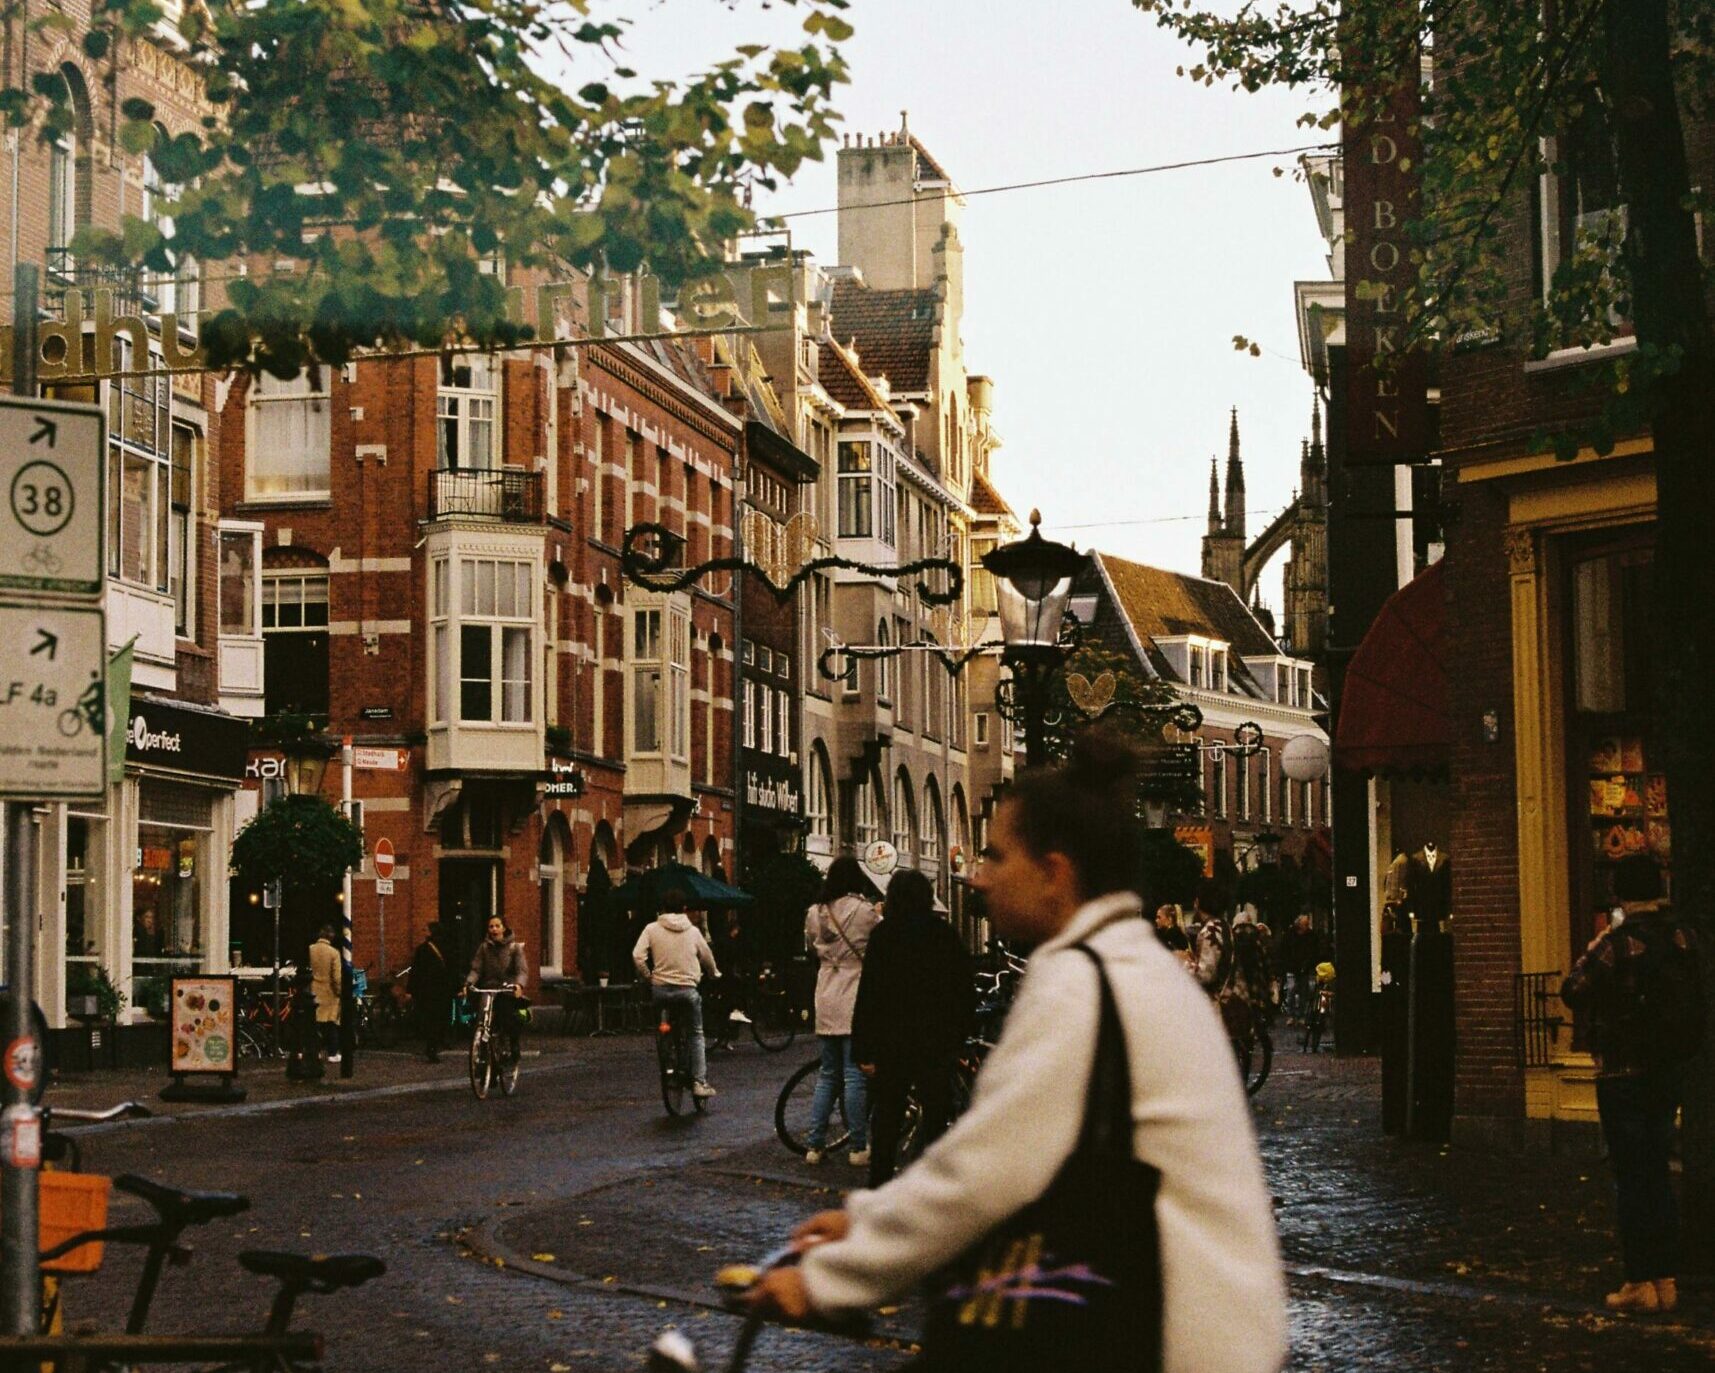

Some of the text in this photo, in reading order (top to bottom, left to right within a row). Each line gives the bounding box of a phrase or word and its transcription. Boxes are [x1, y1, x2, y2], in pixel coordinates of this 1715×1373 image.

[21, 484, 62, 516] 38
[30, 683, 58, 706] 4a
[145, 730, 181, 752] perfect
[758, 776, 776, 809] studio
